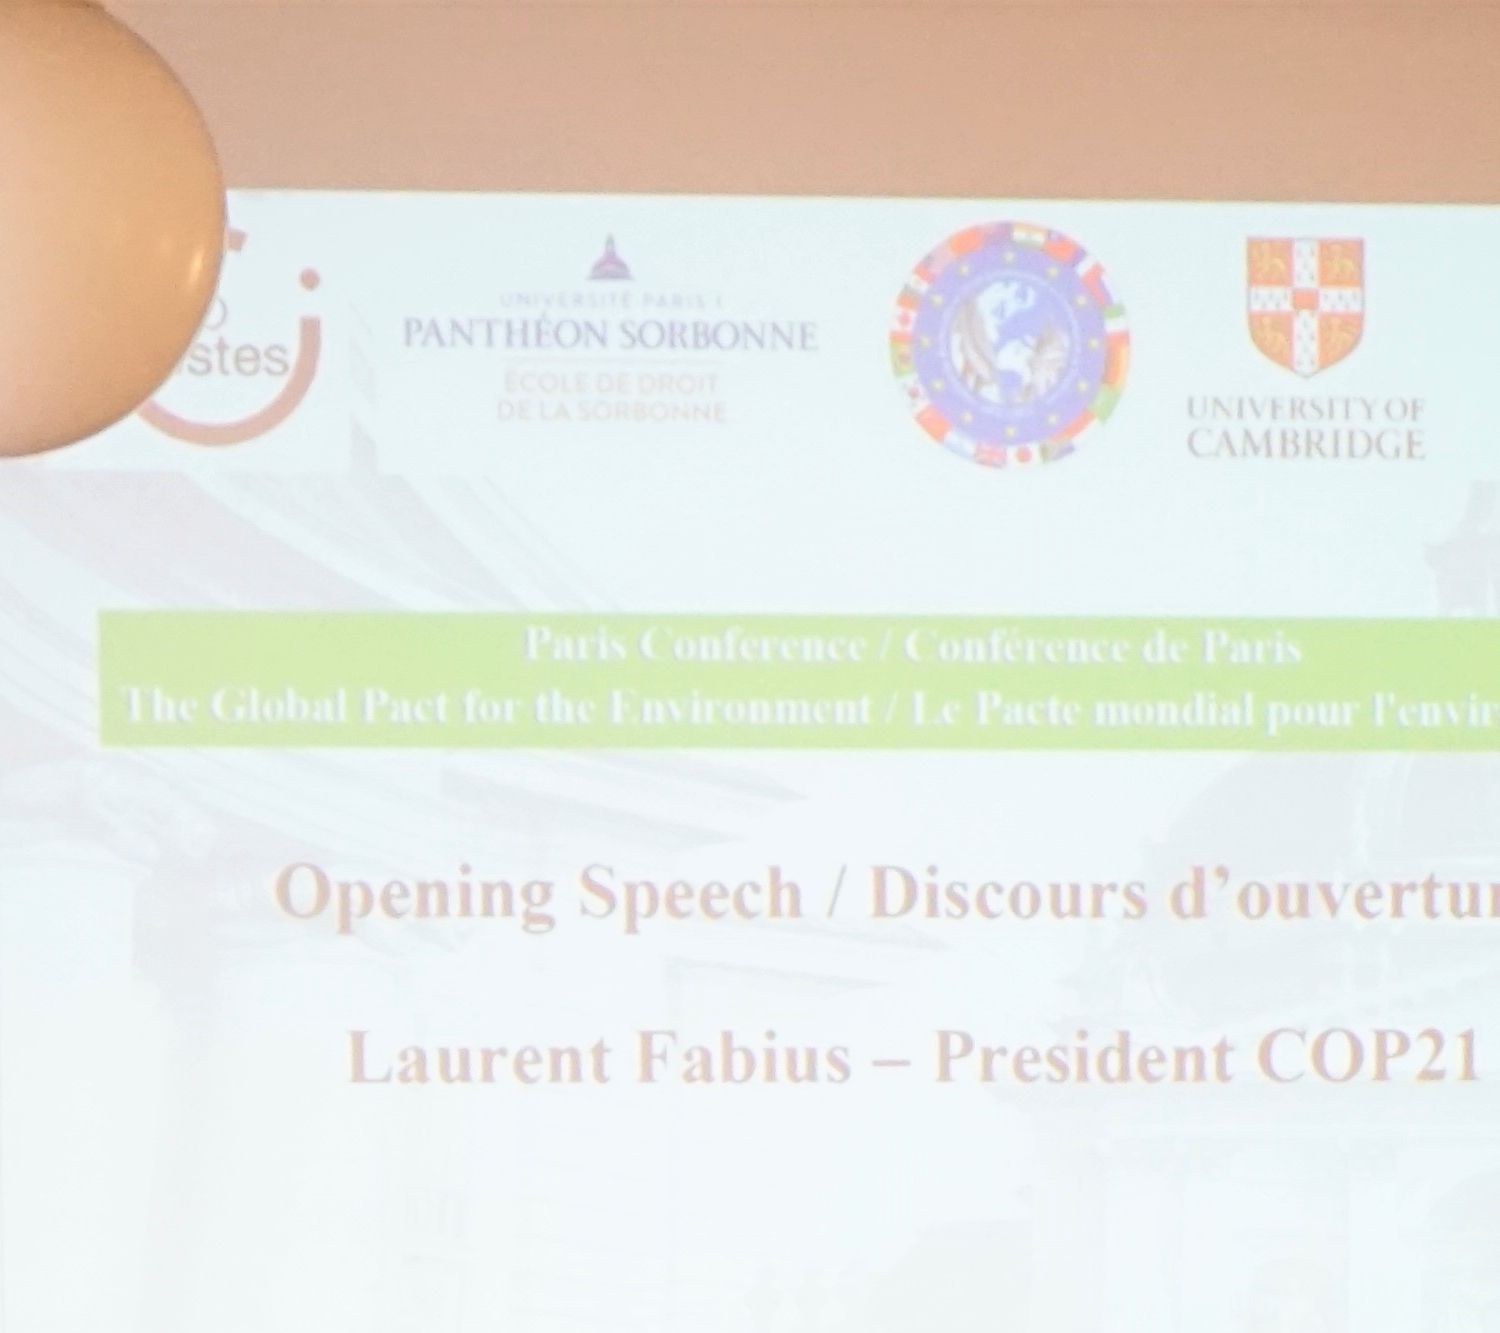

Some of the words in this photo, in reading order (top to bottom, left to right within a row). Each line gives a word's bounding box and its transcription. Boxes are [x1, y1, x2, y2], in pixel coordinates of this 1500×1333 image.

[643, 292, 706, 309] PARIS
[403, 310, 609, 350] PANTHÉON
[619, 317, 819, 352] SORBONNE
[179, 336, 290, 377] stes
[596, 371, 632, 395] DE
[638, 371, 720, 395] DROIT
[497, 399, 531, 421] DE
[540, 399, 571, 421] LA
[577, 399, 729, 423] SORBONNE
[1187, 395, 1378, 421] UNIVERSITY
[1383, 397, 1427, 422] OF
[1187, 427, 1427, 460] CAMBRIDGE
[524, 624, 627, 663] Paris
[640, 624, 868, 664] Conference
[903, 625, 1130, 666] Conférence
[1141, 627, 1187, 666] de
[1201, 628, 1304, 667] Paris
[123, 684, 199, 724] The
[211, 684, 348, 725] Global
[361, 686, 449, 726] Pact
[463, 687, 523, 726] for
[534, 688, 598, 726] the
[609, 688, 874, 728] Environment
[912, 690, 962, 728] Le
[975, 690, 1082, 729] Pacte
[1093, 690, 1255, 730] mondial
[1265, 701, 1359, 737] pour
[273, 861, 556, 936] Opening
[579, 863, 804, 935] Speech
[869, 863, 1148, 921] Discours
[347, 1029, 612, 1085] Laurent
[636, 1028, 852, 1085] Fabius
[935, 1027, 1236, 1085] President
[1256, 1027, 1482, 1084] COP21
